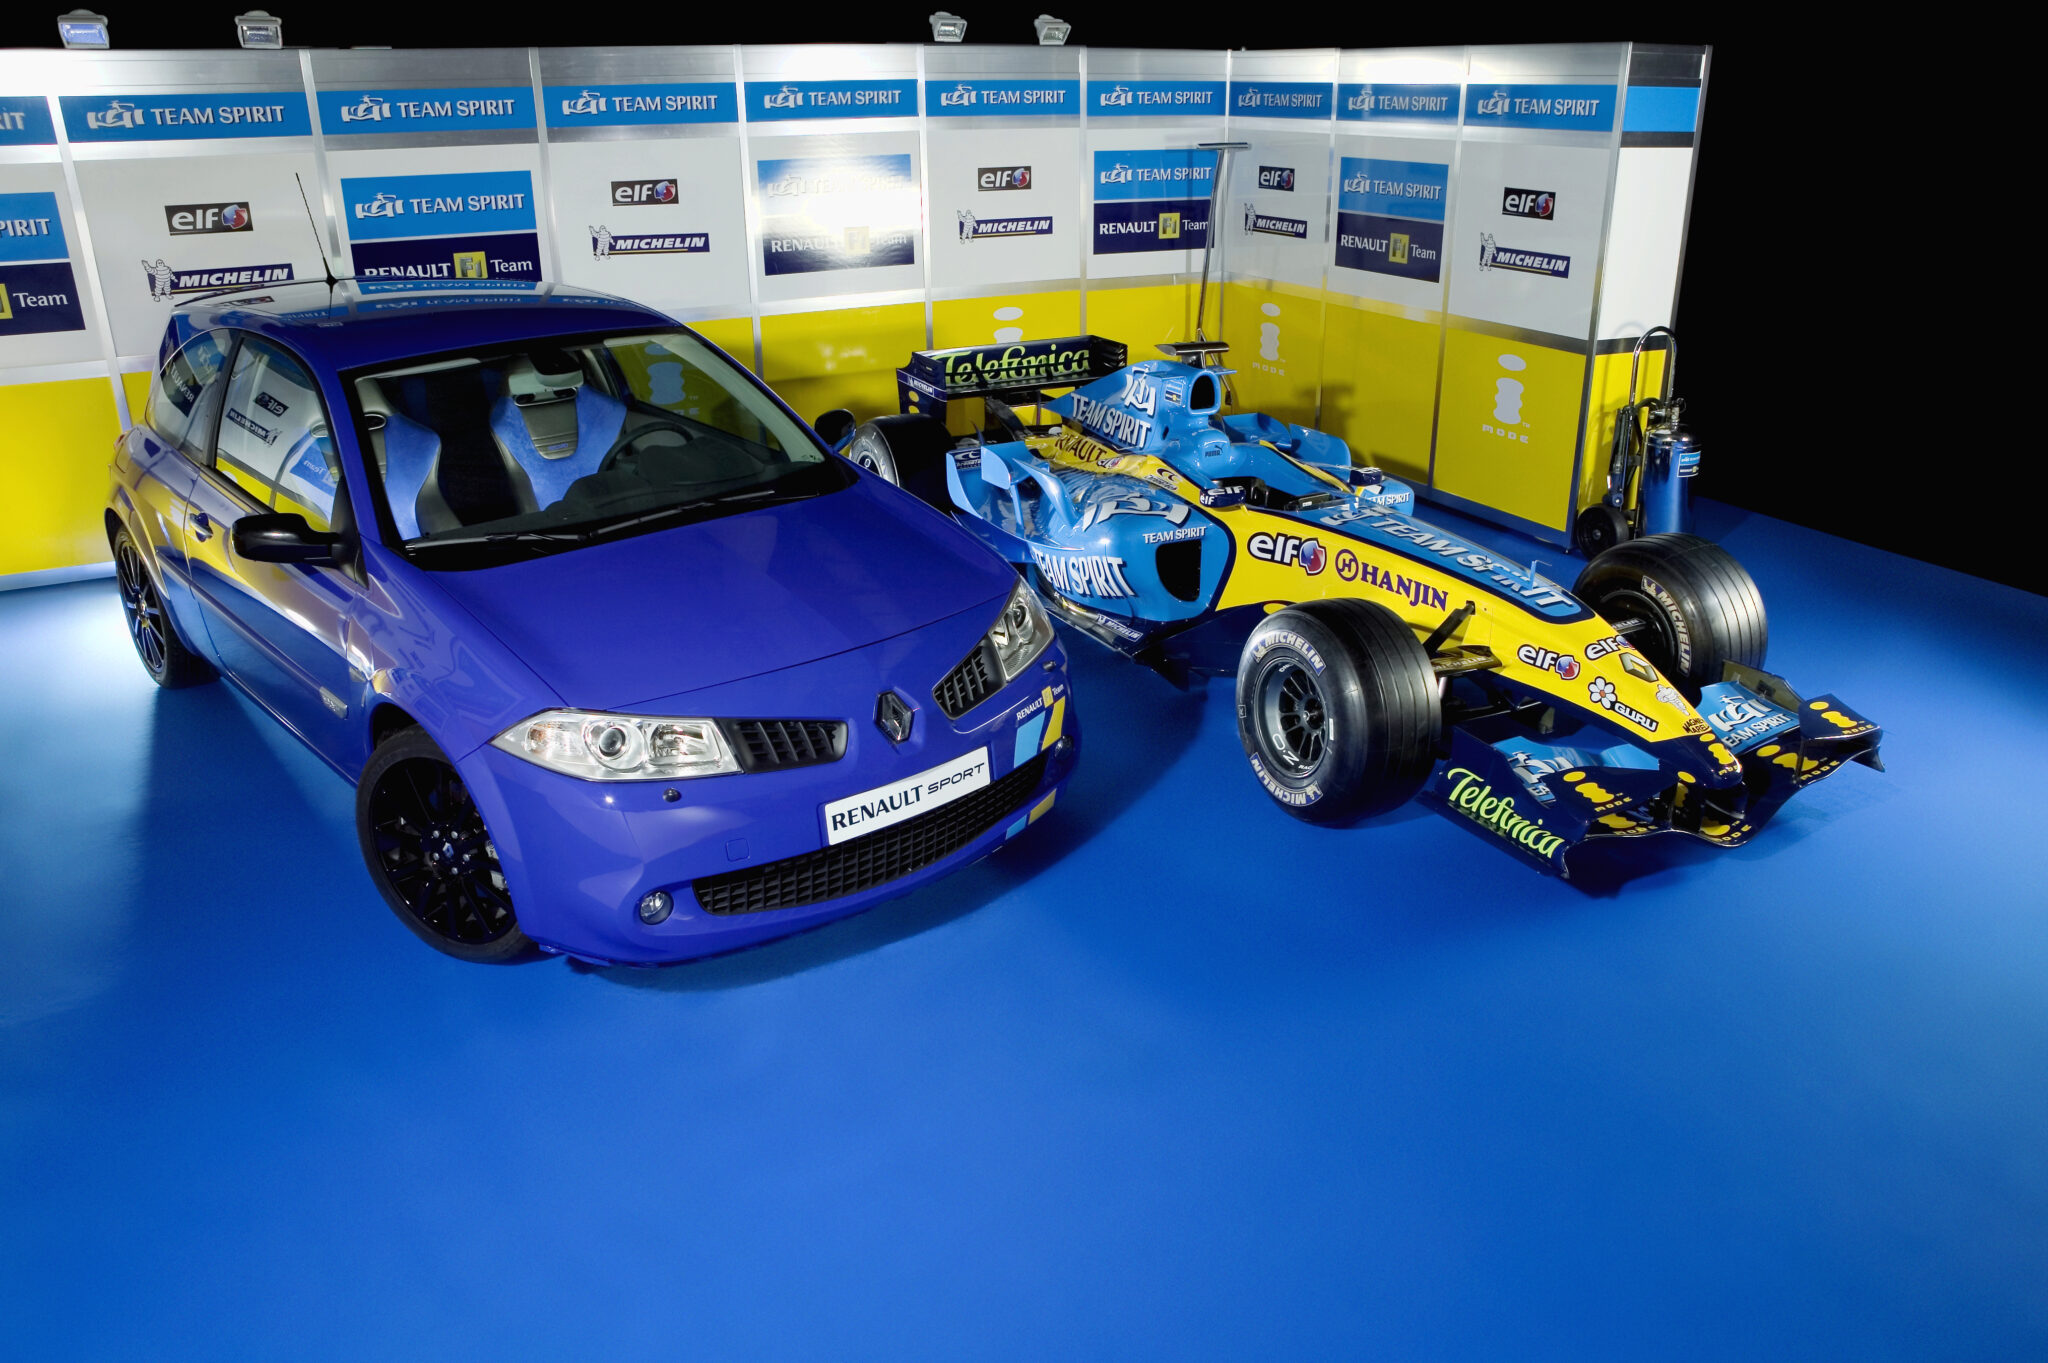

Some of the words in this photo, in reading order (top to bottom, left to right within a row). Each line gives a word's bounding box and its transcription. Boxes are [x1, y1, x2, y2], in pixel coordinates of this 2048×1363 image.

[612, 96, 662, 112] TEAM
[665, 95, 718, 111] SPIRIT
[808, 91, 852, 106] TEAM
[855, 89, 902, 105] SPIRIT
[981, 90, 1020, 104] TEAM
[1023, 90, 1067, 104] SPIRIT
[1136, 91, 1172, 105] TEAM
[1174, 91, 1213, 105] SPIRIT
[1262, 93, 1289, 107] TEAM
[1291, 94, 1323, 108] SPIRIT
[1378, 95, 1409, 110] TEAM
[1411, 96, 1448, 112] SPIRIT
[1513, 97, 1552, 115] TEAM
[1554, 99, 1600, 117] SPIRIT
[150, 107, 214, 125] TEAM
[219, 105, 284, 123] SPIRIT
[397, 101, 452, 119] TEAM
[456, 99, 515, 117] SPIRIT
[980, 170, 1012, 188] elf
[1136, 168, 1172, 182] TEAM
[1174, 167, 1212, 181] SPIRIT
[1259, 170, 1282, 188] elf
[614, 183, 653, 203] elf
[1372, 179, 1403, 197] TEAM
[1405, 182, 1442, 200] SPIRIT
[410, 196, 464, 214] TEAM
[467, 193, 525, 211] SPIRIT
[1504, 193, 1536, 213] elf
[171, 207, 219, 230] elf
[977, 219, 1050, 234] MICHELIN
[1099, 221, 1158, 235] RENAULT
[1182, 218, 1209, 231] Team
[1255, 217, 1306, 234] MICHELIN
[614, 236, 706, 250] MICHELIN
[1340, 234, 1389, 253] RENAULT
[1411, 244, 1436, 260] Team
[490, 258, 533, 273] Team
[1495, 252, 1567, 272] MICHELIN
[179, 268, 290, 288] MICHELIN
[13, 292, 69, 308] Team
[1070, 392, 1108, 430] TEAM
[1103, 407, 1152, 449] SPIRIT
[1387, 491, 1411, 506] SPIRIT
[1143, 532, 1174, 545] TEAM
[1175, 527, 1207, 542] SPIRIT
[1370, 517, 1468, 557] TEAM
[1250, 534, 1301, 565] elf
[1032, 546, 1071, 592] TEAM
[1068, 555, 1136, 598] SPIRIT
[1361, 561, 1449, 612] HANJIN
[1657, 590, 1690, 675] MICHELIN
[1265, 631, 1324, 670] MICHELIN
[1518, 645, 1557, 671] elf
[1586, 636, 1619, 660] elf
[1016, 697, 1043, 721] RENAULT
[1614, 701, 1658, 732] GURU
[1721, 723, 1757, 748] EAM
[1752, 713, 1793, 734] SPIRIT
[1251, 758, 1307, 805] MICHELIN
[831, 784, 923, 832] RENAULT
[927, 762, 985, 795] SPORT
